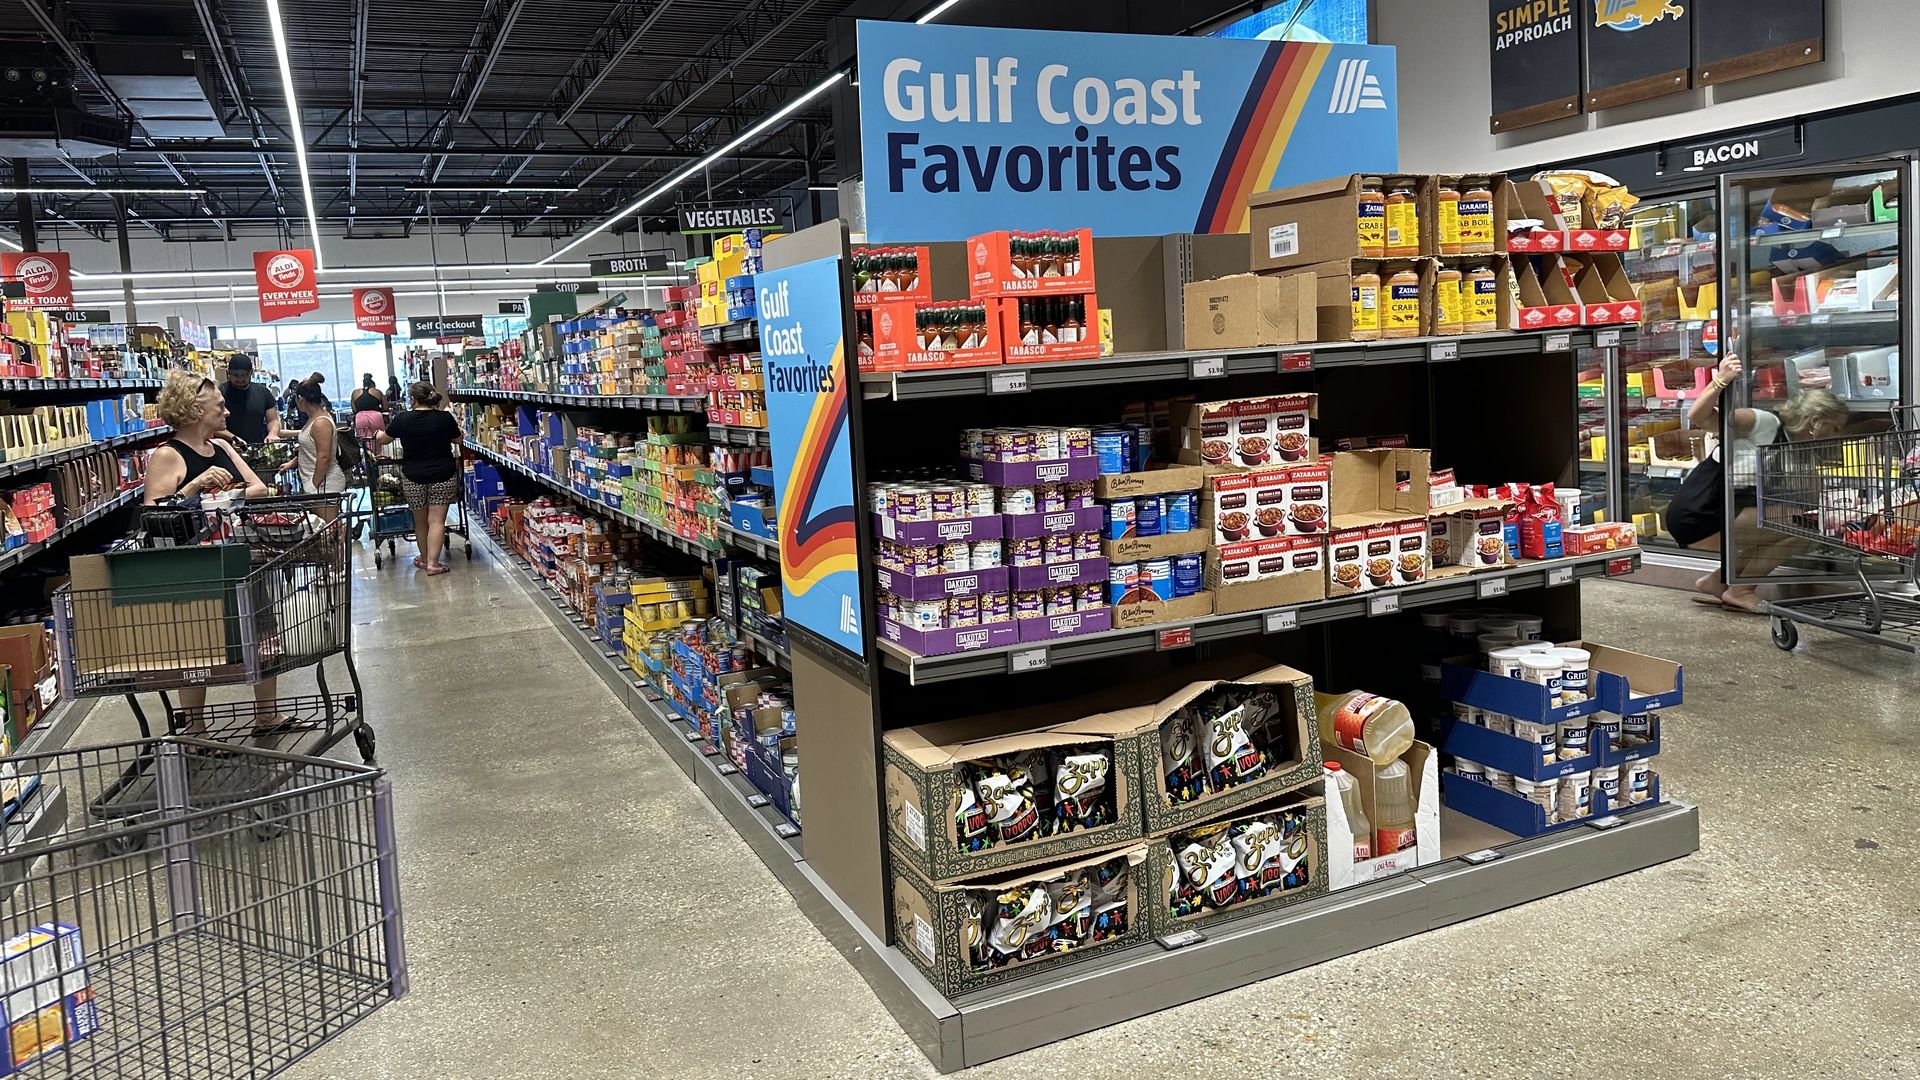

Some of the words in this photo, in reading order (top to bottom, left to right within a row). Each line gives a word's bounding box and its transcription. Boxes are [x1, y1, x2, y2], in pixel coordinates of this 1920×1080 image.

[1497, 0, 1570, 33] SIMPLE
[1496, 15, 1571, 50] APPROACH
[883, 57, 1019, 123] Gulf
[1036, 64, 1201, 125] Coast
[1693, 140, 1759, 165] BACON
[887, 126, 1182, 193] Favorites
[686, 207, 776, 228] VEGETABLES
[274, 263, 294, 273] ALDI
[610, 258, 647, 272] BROTH
[25, 266, 47, 276] ALDI
[278, 271, 296, 281] finds
[29, 274, 50, 285] finds
[555, 283, 580, 292] SOUP
[1002, 280, 1038, 291] TABASCO
[37, 296, 68, 304] TODAY
[262, 291, 288, 300] EVERY
[290, 290, 314, 299] WEEK
[760, 280, 789, 321] Gulf
[853, 295, 877, 304] ASCO
[65, 312, 87, 321] OILS
[416, 322, 433, 331] Self
[764, 321, 803, 358] Coast
[1009, 345, 1045, 356] TABASCO
[907, 352, 945, 363] TABASCO
[768, 354, 835, 394] Favorites
[1009, 381, 1026, 389] $1.89
[1039, 466, 1067, 477] DAKOTA'S
[1110, 478, 1126, 490] Blue
[1125, 475, 1145, 486] Runner
[1220, 478, 1249, 486] ZATARAIN'S
[1257, 474, 1286, 482] ZATARAIN'S
[1046, 515, 1073, 526] DAKOTA'S
[1401, 522, 1426, 530] ZATARAIN'S
[940, 523, 970, 535] DAKOTA'S
[1335, 531, 1362, 539] ZATARAIN'S
[1583, 531, 1610, 543] Luzianne
[1117, 543, 1133, 554] Blue
[1131, 539, 1152, 551] Runner
[1224, 547, 1253, 555] ZATARAIN'S
[1259, 543, 1287, 551] ZATARAIN'S
[1051, 566, 1078, 577] DAKOTA'S
[947, 578, 975, 590] DAKOTA'S
[1120, 609, 1136, 620] Blue
[1134, 605, 1155, 616] Runner
[1052, 617, 1079, 628] DAKOTA'S
[958, 632, 986, 644] DAKOTA'S
[1029, 658, 1047, 666] $0.95
[1566, 671, 1588, 680] GRITS
[1623, 716, 1645, 724] GRITS
